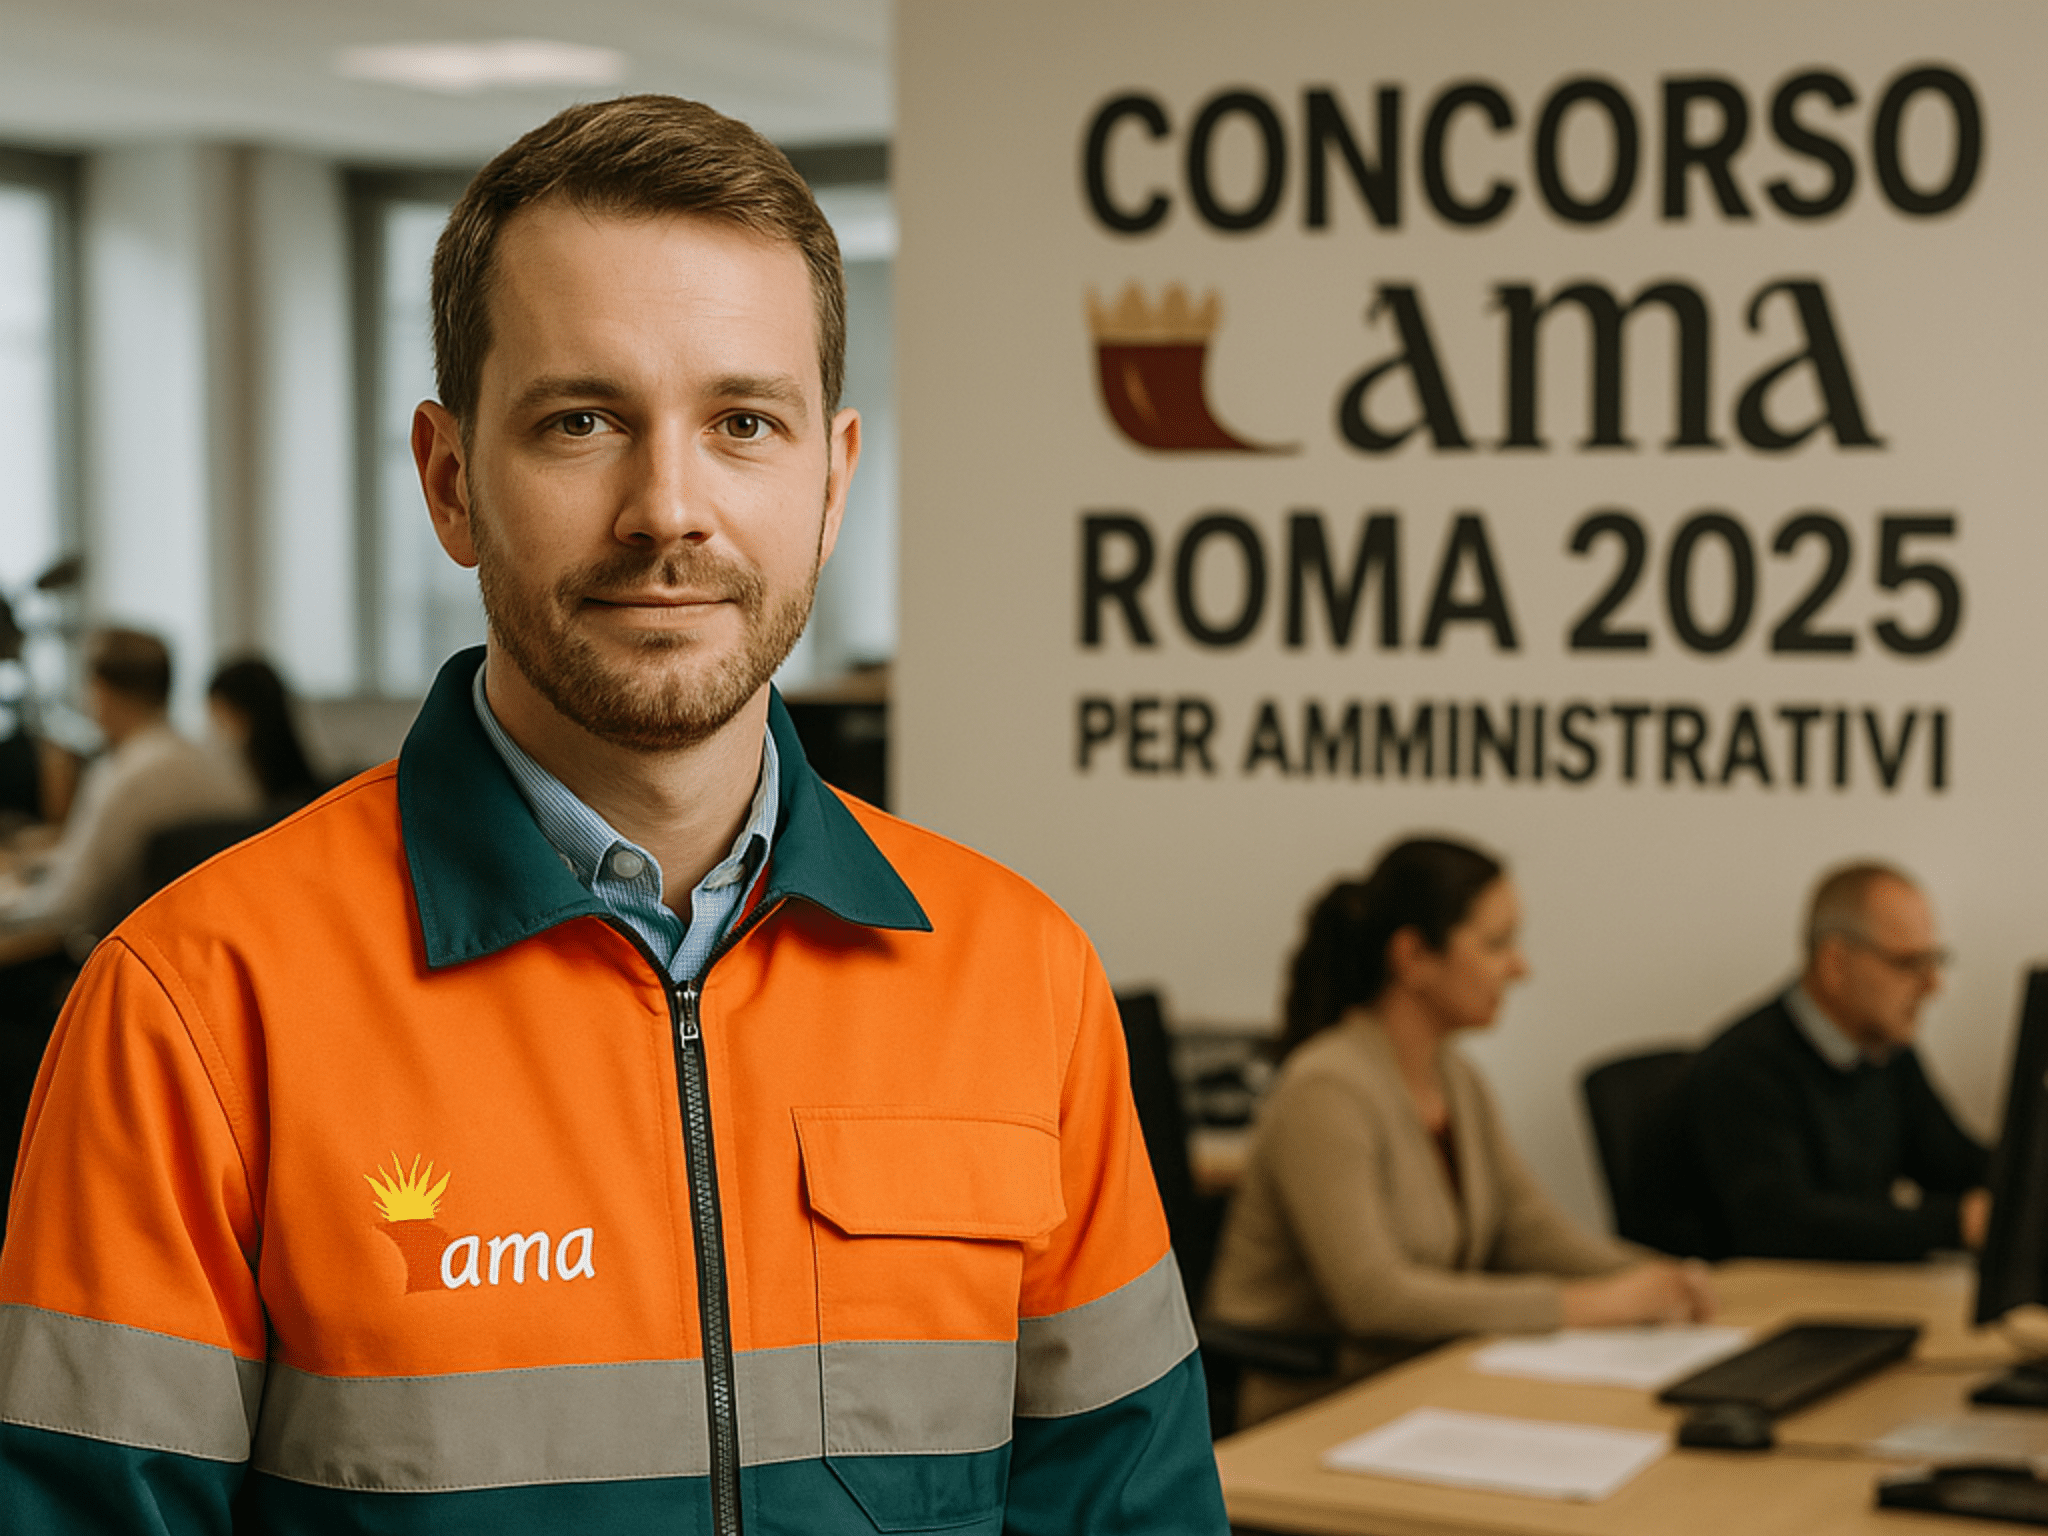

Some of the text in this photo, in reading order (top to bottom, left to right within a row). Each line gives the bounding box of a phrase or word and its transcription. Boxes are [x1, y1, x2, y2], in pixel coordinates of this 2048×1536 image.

[1079, 61, 1986, 239] CONCORSO
[1334, 275, 1889, 457] ama
[1077, 507, 1964, 658] ROMA 2025
[1075, 693, 1951, 792] PER AMMINISTRATIVI
[440, 1226, 596, 1290] ama
